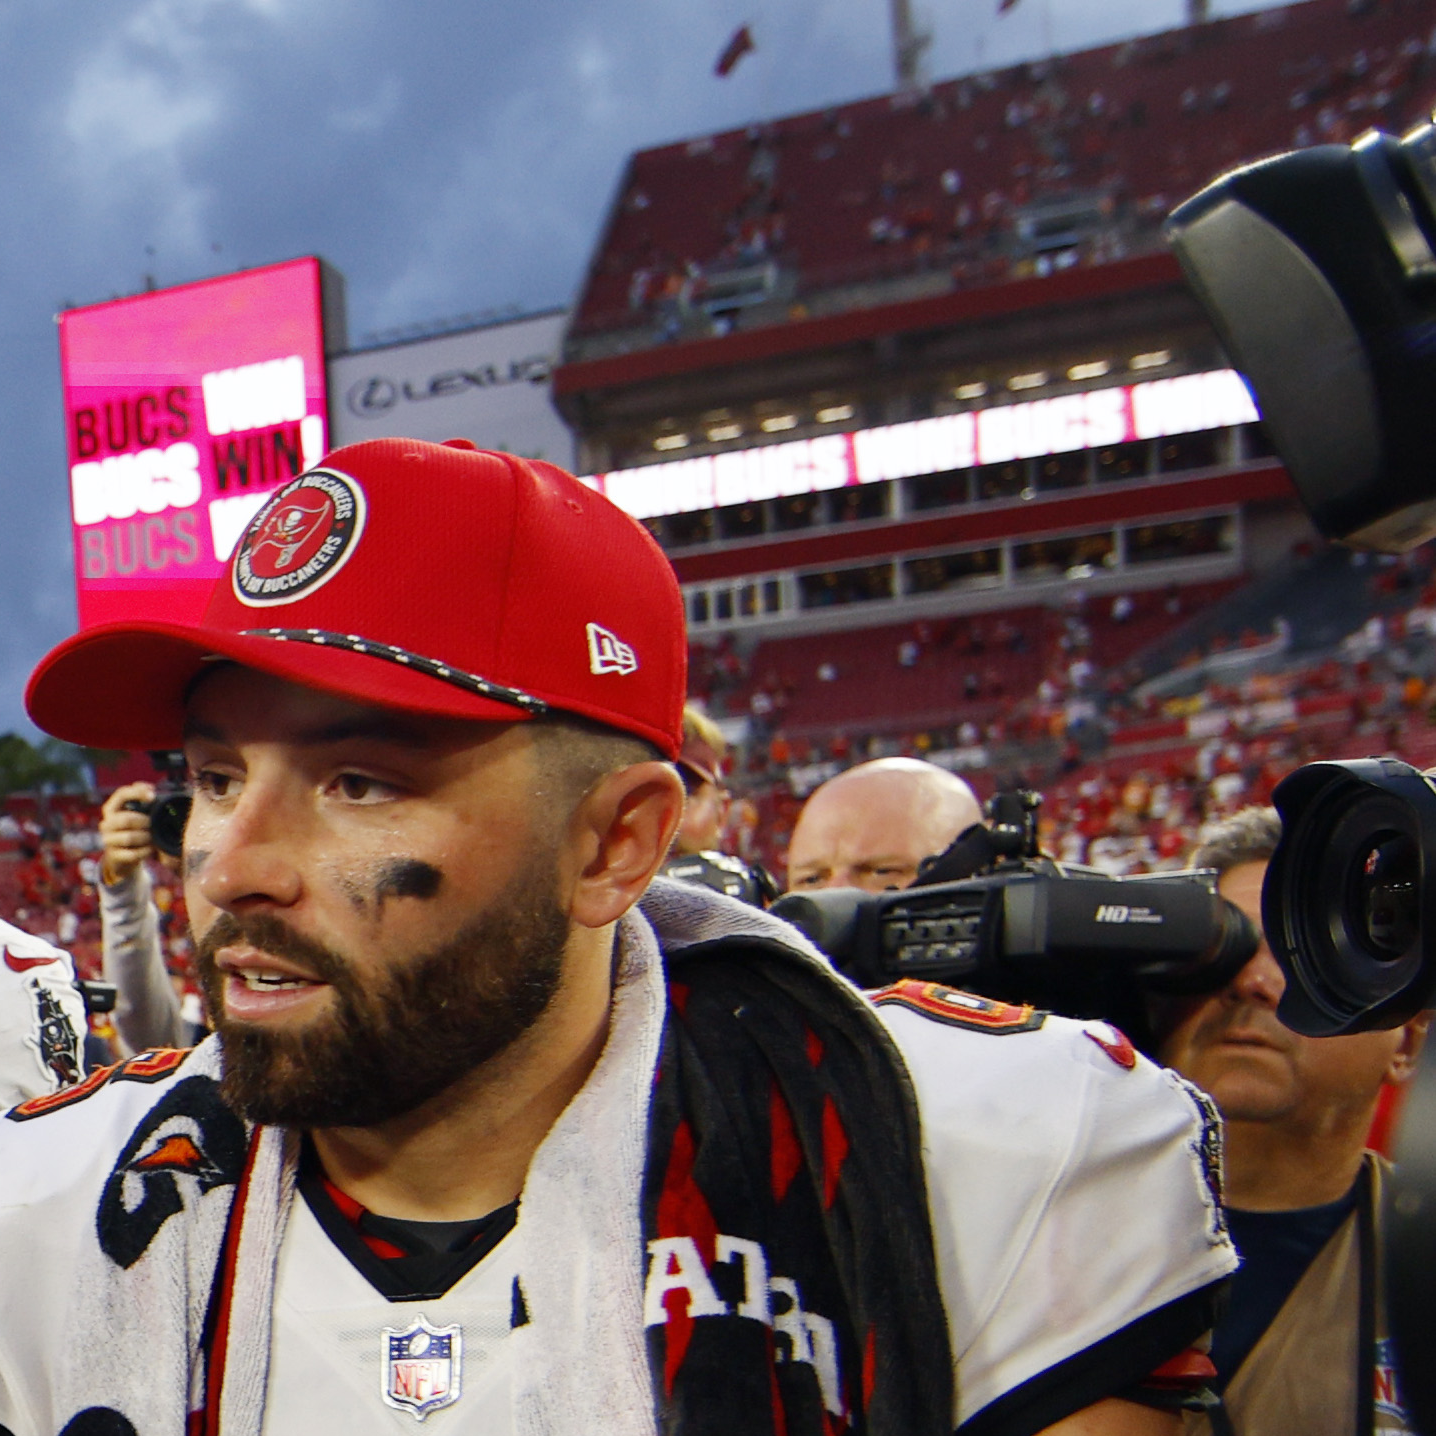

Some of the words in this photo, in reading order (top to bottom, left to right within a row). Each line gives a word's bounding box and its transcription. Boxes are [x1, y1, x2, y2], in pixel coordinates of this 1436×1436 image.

[401, 356, 553, 402] LEXUS
[74, 386, 190, 458] BUCS
[71, 441, 202, 525] BUCS
[301, 476, 353, 520] BUCCANEERS
[82, 511, 198, 578] BUCS
[261, 535, 343, 594] BUCCANEERS
[393, 1362, 447, 1401] NFL
